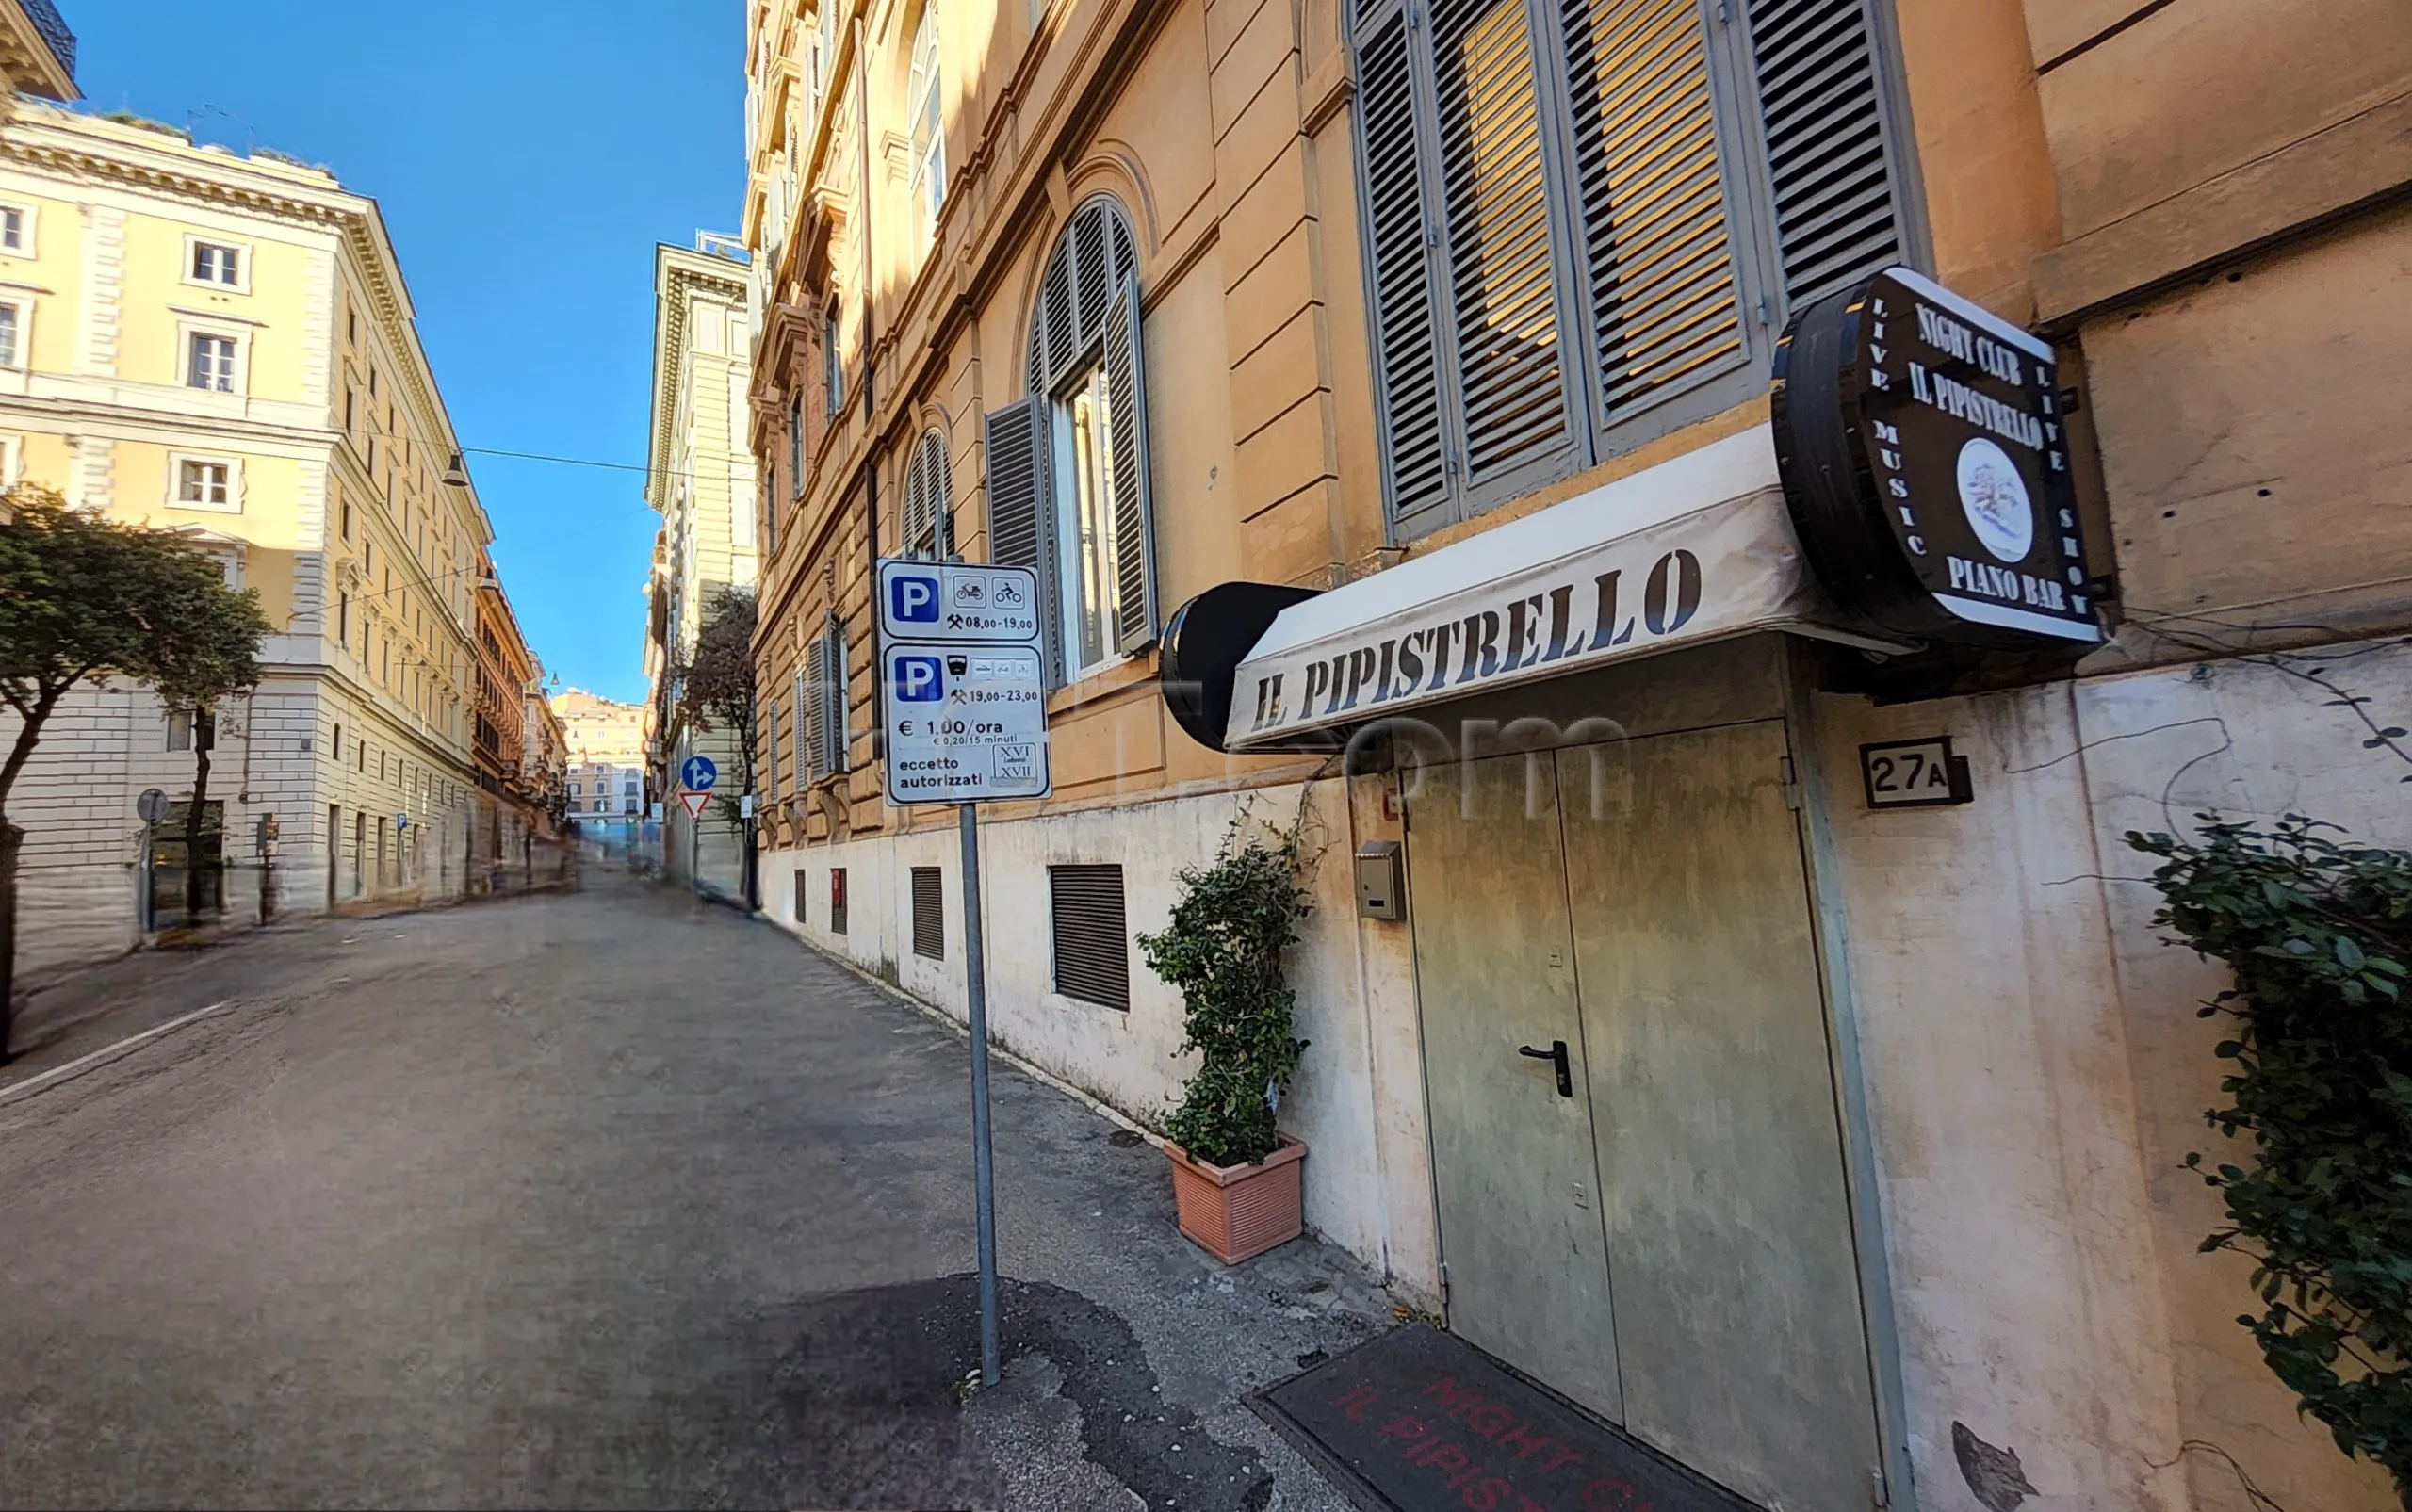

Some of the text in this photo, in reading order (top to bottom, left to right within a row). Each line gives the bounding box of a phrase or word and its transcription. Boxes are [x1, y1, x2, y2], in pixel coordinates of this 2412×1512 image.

[1915, 302, 2023, 387] NIGHT CLUB
[1908, 362, 2044, 452] IL PIPISTRELLO
[1870, 298, 1927, 555] LIVE MUSIC
[2036, 366, 2088, 615] LIVE SHOW
[903, 582, 930, 617] P
[1947, 556, 2066, 611] PIANO BAR
[1250, 549, 1703, 732] IL PIPISTRELLO
[906, 661, 934, 697] P
[898, 720, 914, 737] €
[984, 734, 1018, 744] minuti
[899, 757, 959, 771] eccetto
[1000, 745, 1029, 757] XVI
[900, 772, 983, 789] autorizzati
[1002, 766, 1030, 778] XVII
[1871, 754, 1947, 791] 27A
